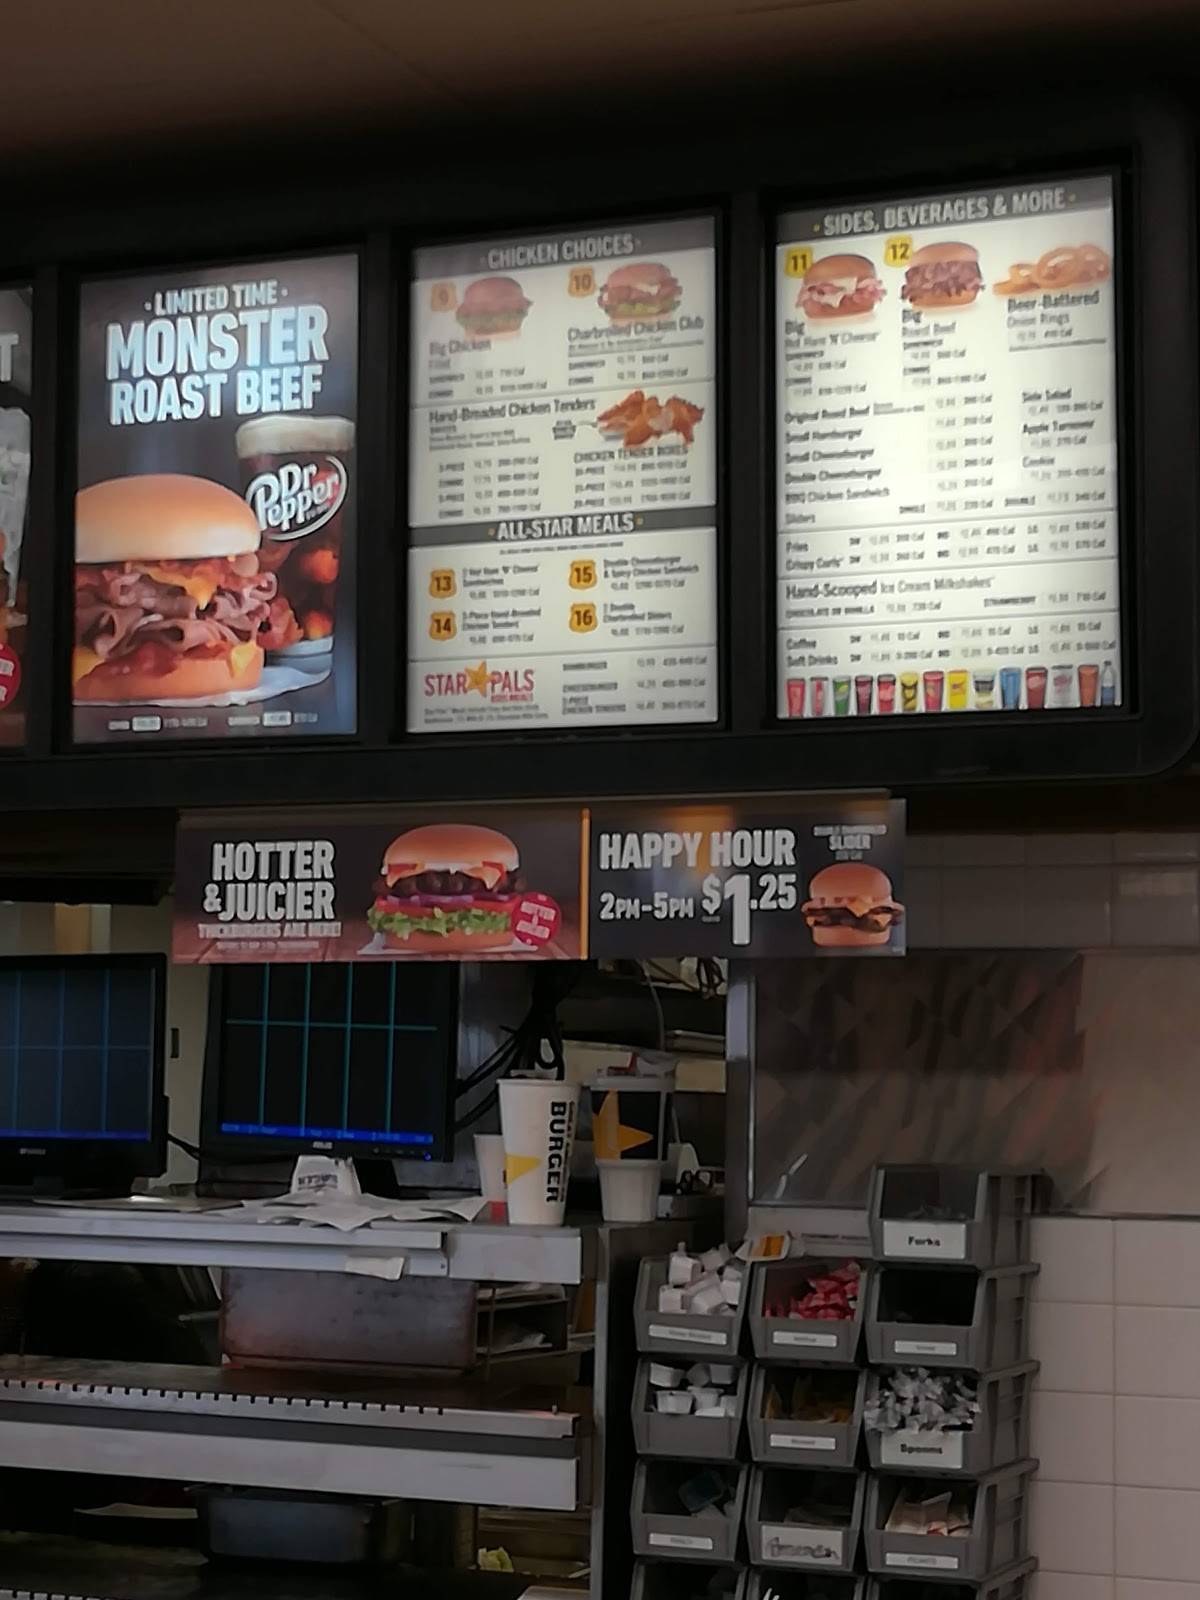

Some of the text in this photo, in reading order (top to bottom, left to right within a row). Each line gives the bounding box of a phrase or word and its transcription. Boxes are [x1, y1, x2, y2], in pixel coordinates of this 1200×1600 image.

[823, 188, 1066, 235] SIDES, BEVERAGES & MORE
[488, 234, 635, 269] CHICKEN CHOICES
[791, 254, 807, 272] 11
[890, 243, 910, 261] 12
[573, 273, 592, 291] 10
[155, 285, 228, 316] LIMITED
[106, 303, 329, 381] MONSTER
[110, 365, 324, 425] ROAST BEEF
[245, 463, 340, 532] Dr Pepper
[497, 513, 635, 540] ALL-STAR MEALS
[435, 576, 452, 592] 13
[575, 566, 593, 584] 15
[786, 579, 877, 599] Hand-Scooped
[434, 617, 452, 633] 14
[575, 609, 593, 626] 16
[424, 671, 468, 697] STAR
[491, 669, 535, 695] PALS
[212, 840, 335, 881] HOTTER
[600, 830, 796, 870] HAPPY HOUR
[546, 1101, 567, 1203] BURGER
[908, 1235, 942, 1248] Forks
[900, 1443, 943, 1456] Spoons
